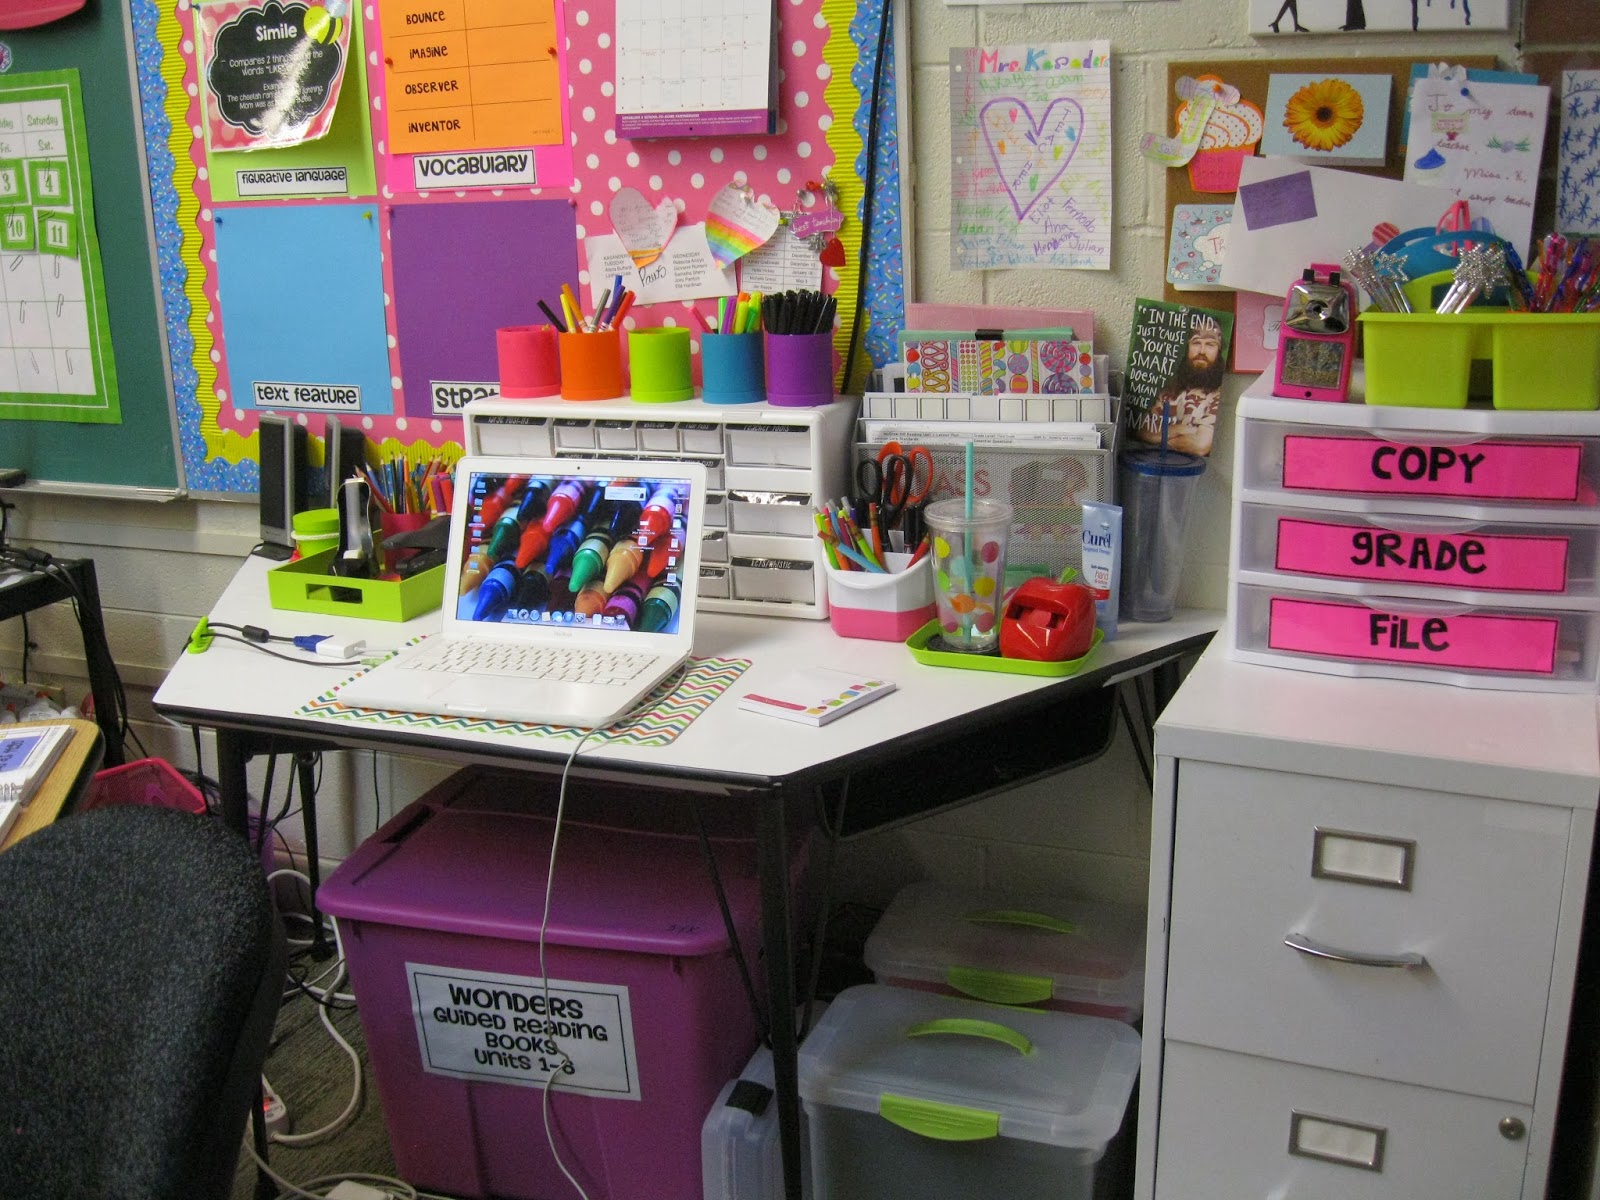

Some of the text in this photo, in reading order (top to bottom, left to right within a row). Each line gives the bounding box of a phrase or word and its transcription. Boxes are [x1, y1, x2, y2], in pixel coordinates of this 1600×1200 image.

[255, 23, 298, 42] Simile
[229, 57, 265, 71] Compares
[266, 55, 271, 65] 2
[27, 114, 59, 127] Saturday
[38, 139, 54, 151] Sat.
[45, 175, 54, 194] 4
[11, 220, 64, 244] 10 11
[1168, 310, 1188, 329] THE
[1137, 324, 1156, 337] JUST
[1142, 337, 1180, 358] YOU'RE
[1130, 381, 1158, 398] MEAN
[1371, 446, 1486, 483] COPY
[1082, 530, 1112, 548] Curél
